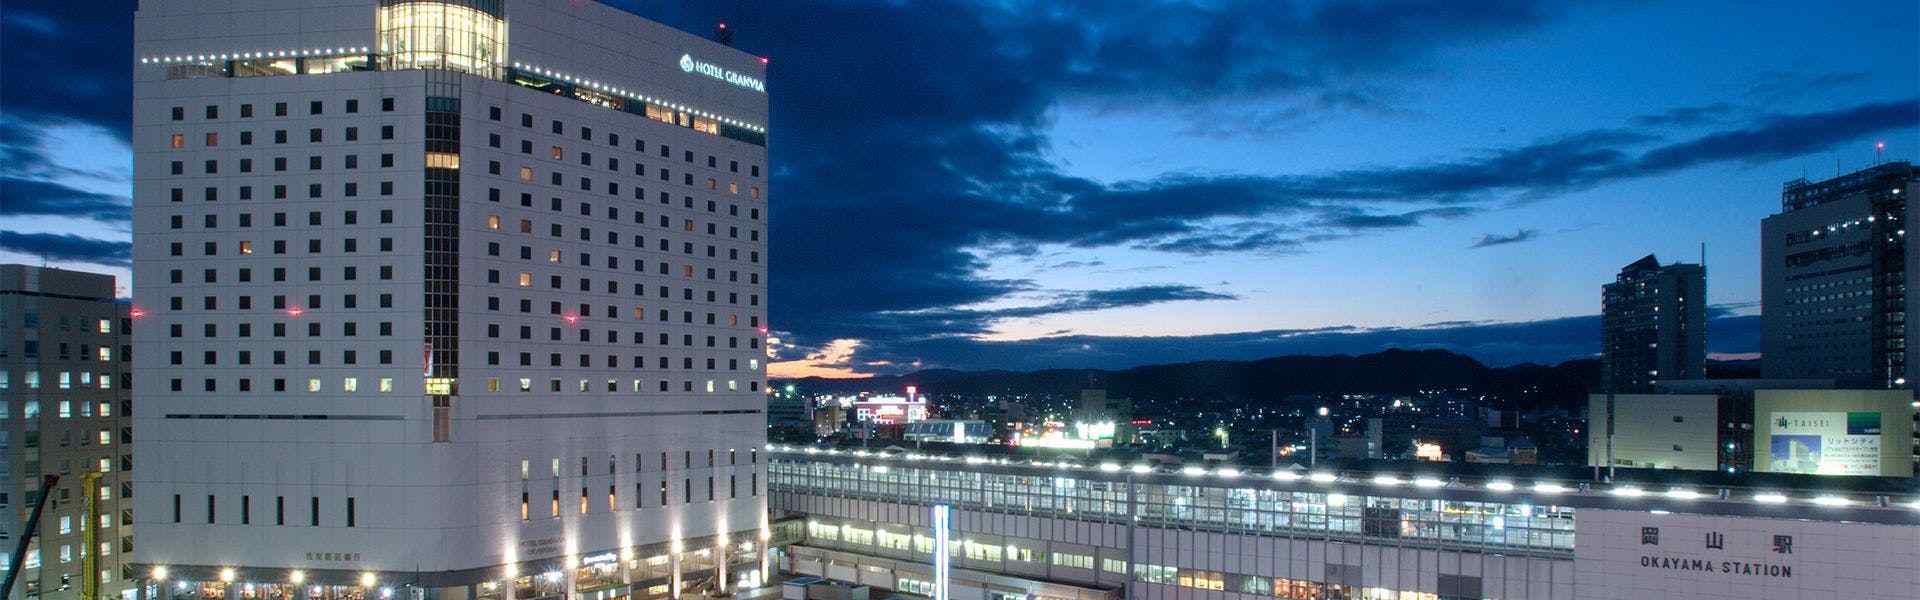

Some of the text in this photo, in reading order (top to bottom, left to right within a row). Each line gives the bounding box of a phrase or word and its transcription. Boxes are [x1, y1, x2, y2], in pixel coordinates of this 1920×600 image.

[696, 61, 764, 92] HOTEL GRANVIA
[1640, 555, 1792, 577] OKAYAMA STATION
